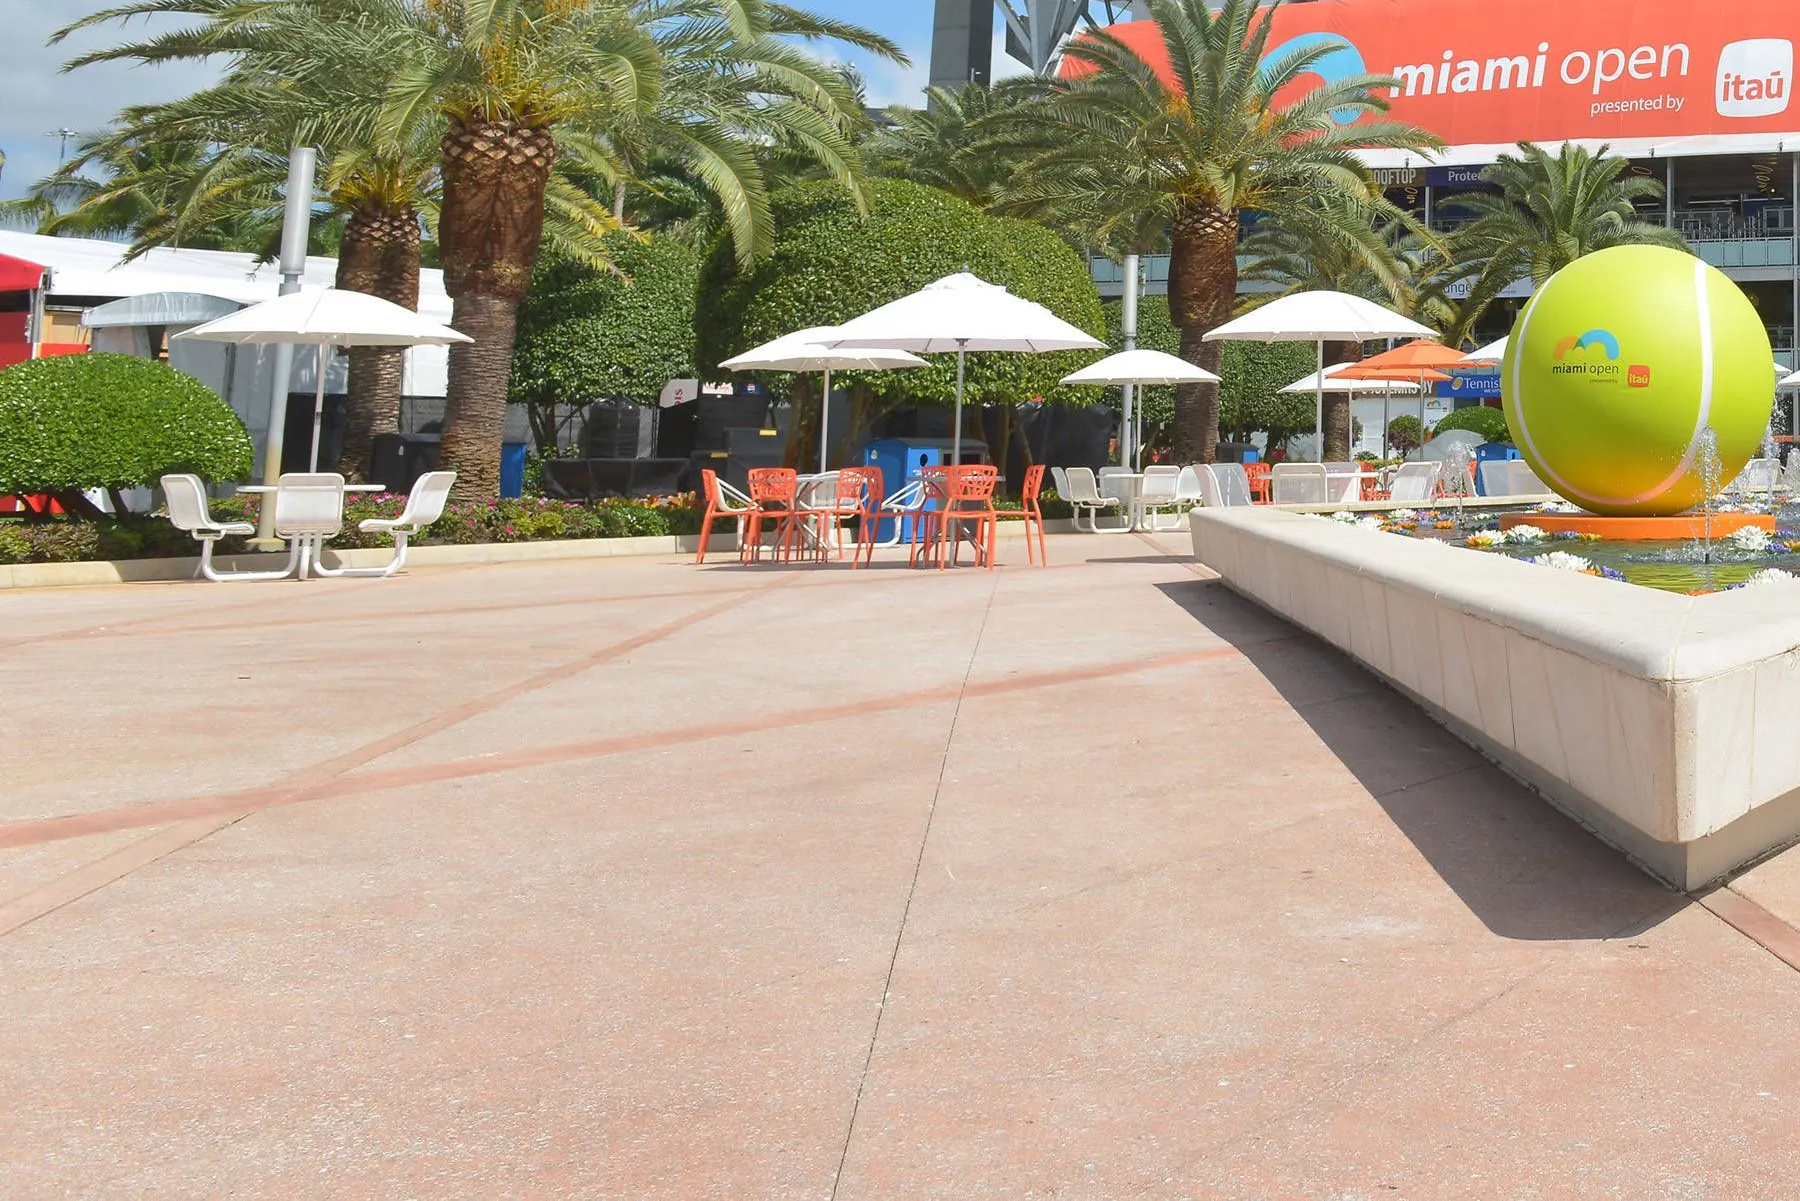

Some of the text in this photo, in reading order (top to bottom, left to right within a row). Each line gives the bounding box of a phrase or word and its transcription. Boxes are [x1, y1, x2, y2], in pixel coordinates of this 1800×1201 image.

[1388, 41, 1691, 98] miami open
[1721, 69, 1785, 103] itaú
[1590, 94, 1685, 117] presented by
[1373, 168, 1417, 185] OOFTOP
[1552, 362, 1619, 376] miami open
